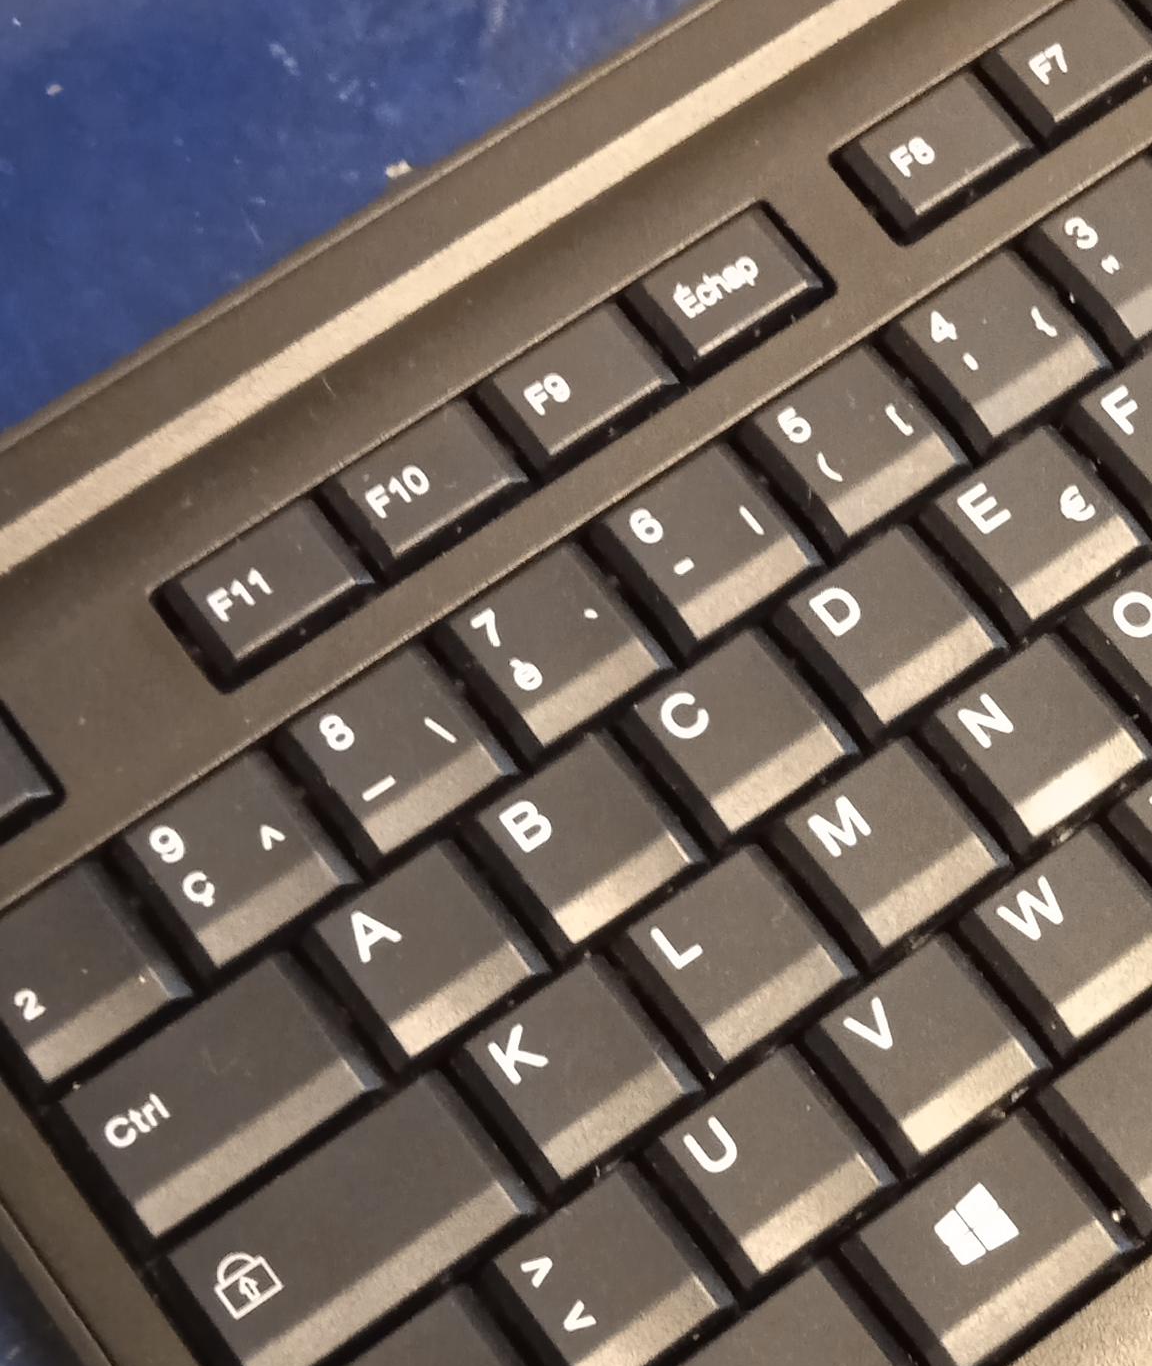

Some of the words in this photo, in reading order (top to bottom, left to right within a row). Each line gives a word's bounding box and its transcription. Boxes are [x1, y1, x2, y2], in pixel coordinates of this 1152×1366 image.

[1027, 42, 1069, 86] F7
[889, 136, 936, 178] F8
[1064, 216, 1099, 250] 3
[930, 310, 958, 344] 4
[523, 372, 571, 416] F9
[1100, 384, 1139, 436] F
[776, 406, 812, 444] 5
[364, 465, 430, 519] F10
[956, 481, 1012, 535] E
[1059, 484, 1096, 522] €
[628, 508, 664, 544] 6
[206, 568, 273, 622] F11
[808, 586, 862, 637] D
[470, 607, 501, 648] 7
[318, 714, 355, 752] 8
[660, 691, 710, 740] C
[957, 692, 1015, 749] N
[148, 825, 186, 864] 9
[498, 800, 553, 853] B
[807, 794, 872, 858] M
[995, 874, 1065, 942] W
[350, 911, 403, 964] A
[650, 927, 704, 970] L
[842, 996, 894, 1051] V
[487, 1023, 549, 1085] K
[104, 1093, 171, 1148] Ctrl
[682, 1116, 738, 1174] U
